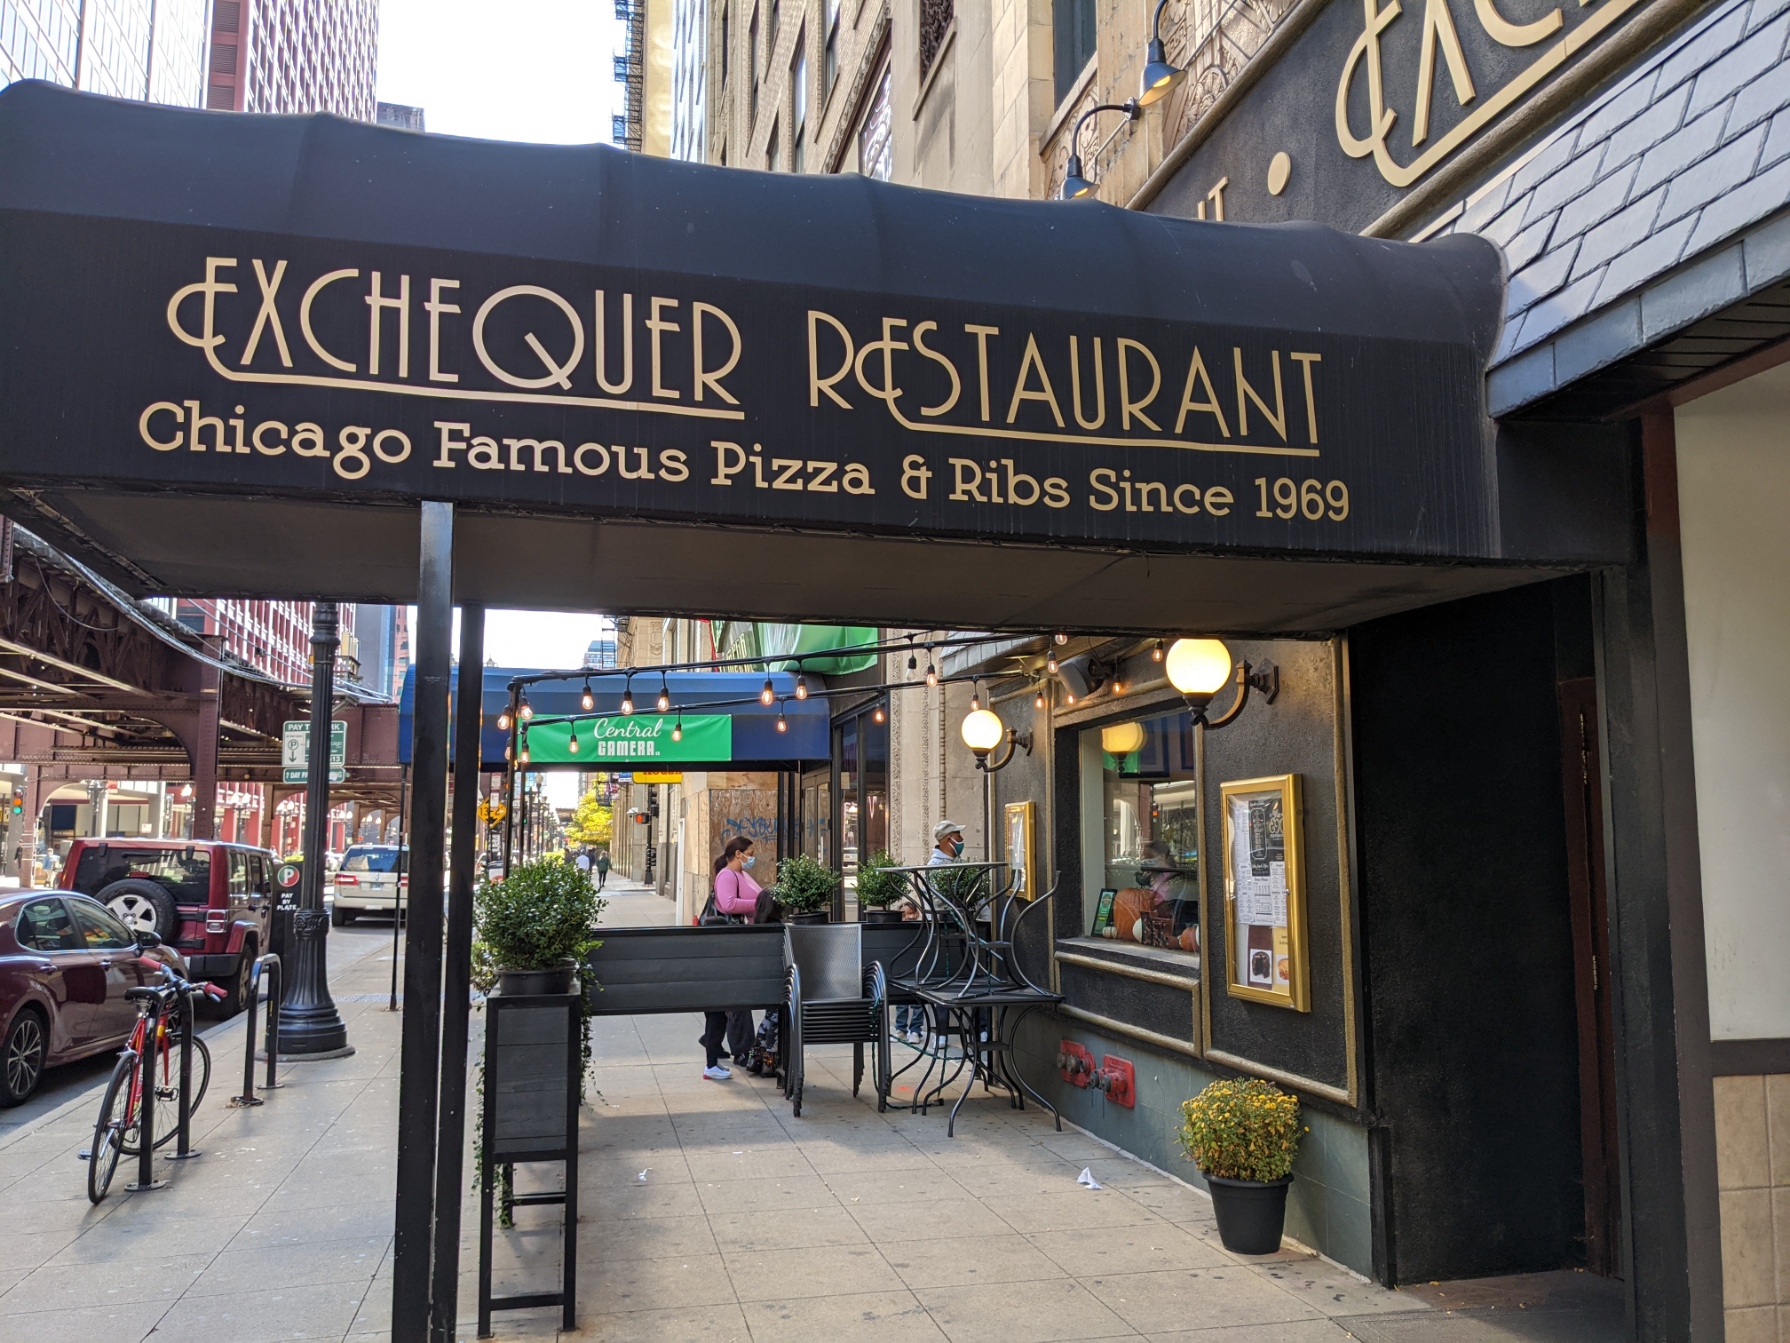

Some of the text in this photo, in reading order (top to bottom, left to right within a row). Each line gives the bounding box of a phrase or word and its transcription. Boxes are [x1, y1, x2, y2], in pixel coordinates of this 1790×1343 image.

[167, 257, 1321, 457] EXCHEQUER RESTAURANT
[139, 400, 1349, 521] Chicago Famous Pizza & Ribs Since 1969
[594, 718, 663, 738] Central
[598, 741, 655, 756] CAMERA
